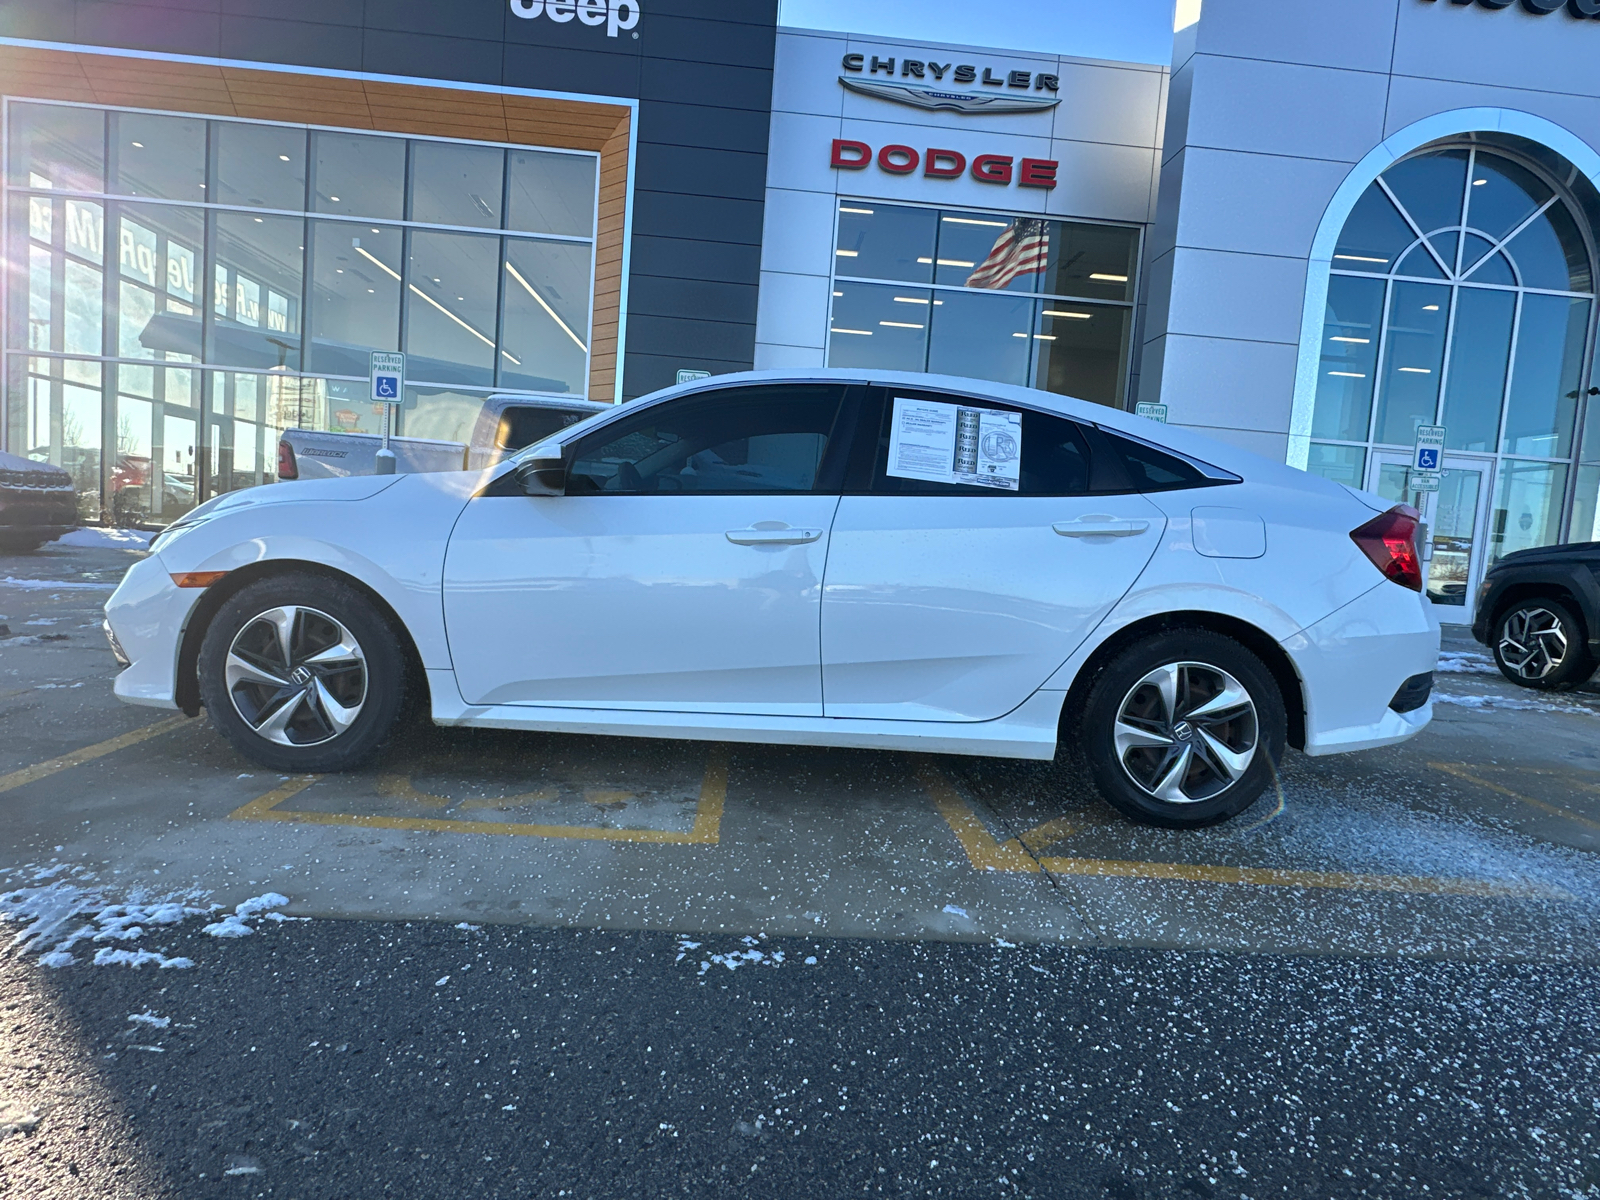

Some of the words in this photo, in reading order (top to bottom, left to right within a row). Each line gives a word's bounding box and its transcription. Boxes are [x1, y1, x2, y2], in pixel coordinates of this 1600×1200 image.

[842, 53, 1060, 91] CHRYSLER
[830, 139, 1059, 190] DODGE
[373, 355, 402, 364] RESERVED
[373, 364, 402, 373] PARKING
[1139, 406, 1165, 415] RESERVED
[1419, 428, 1444, 437] RESERVED
[1418, 437, 1443, 445] PARKING
